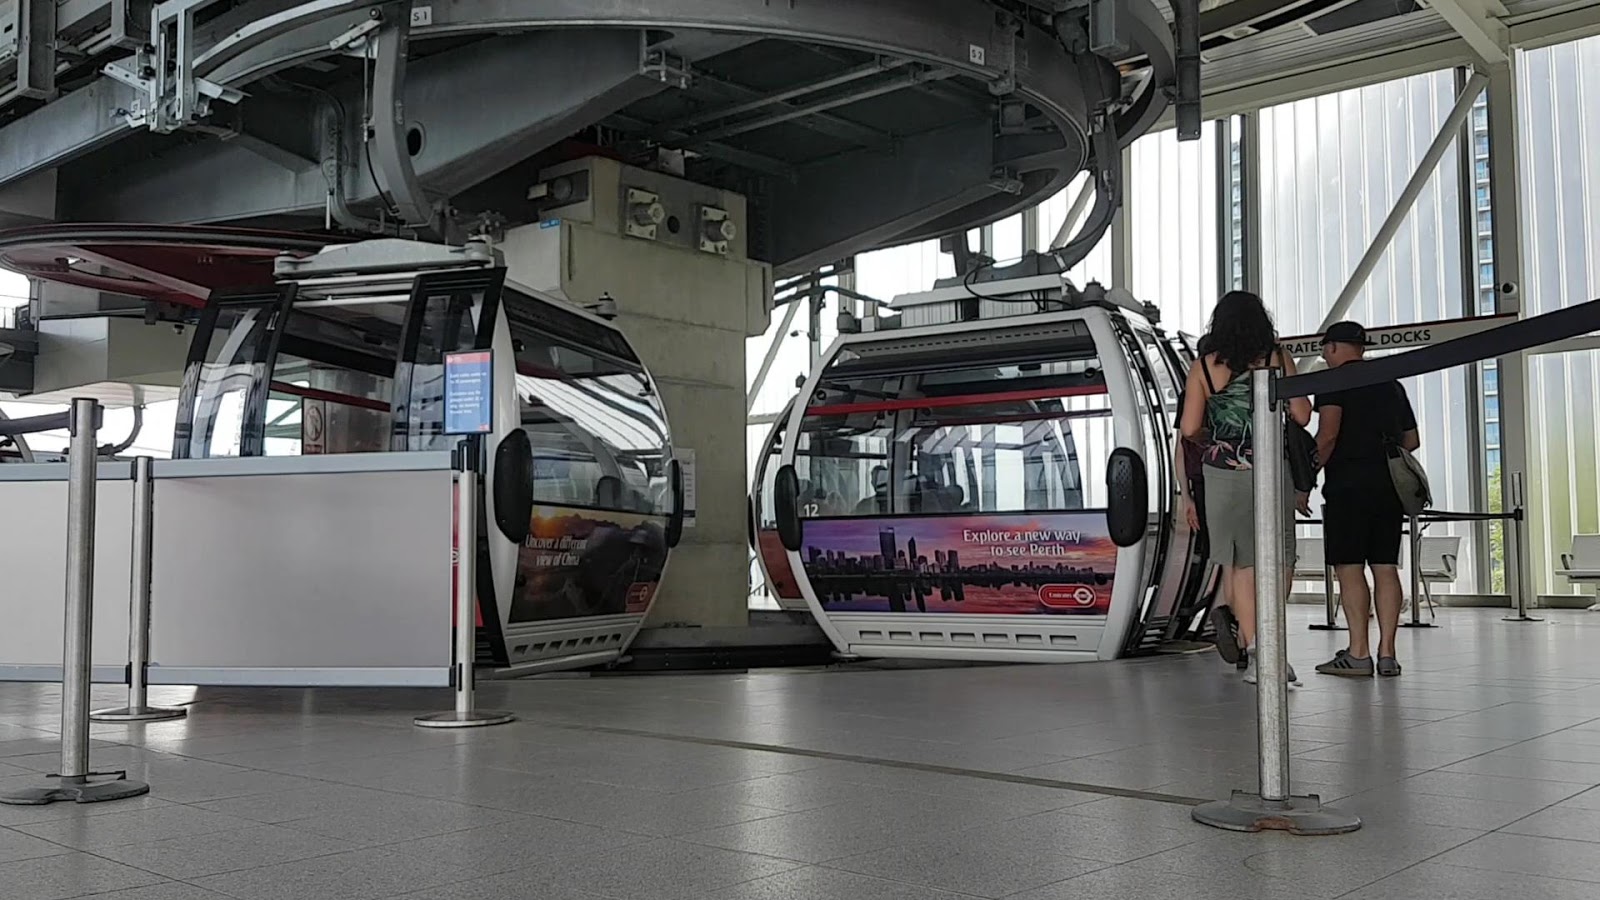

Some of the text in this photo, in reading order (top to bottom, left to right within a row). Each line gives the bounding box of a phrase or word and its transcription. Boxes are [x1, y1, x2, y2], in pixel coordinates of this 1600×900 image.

[1380, 329, 1431, 345] DOCKS
[803, 503, 820, 518] 12
[554, 538, 559, 549] a
[560, 535, 588, 550] different
[963, 529, 1081, 544] Explore a new way
[990, 543, 1065, 556] to see Perth
[536, 552, 580, 567] view of China
